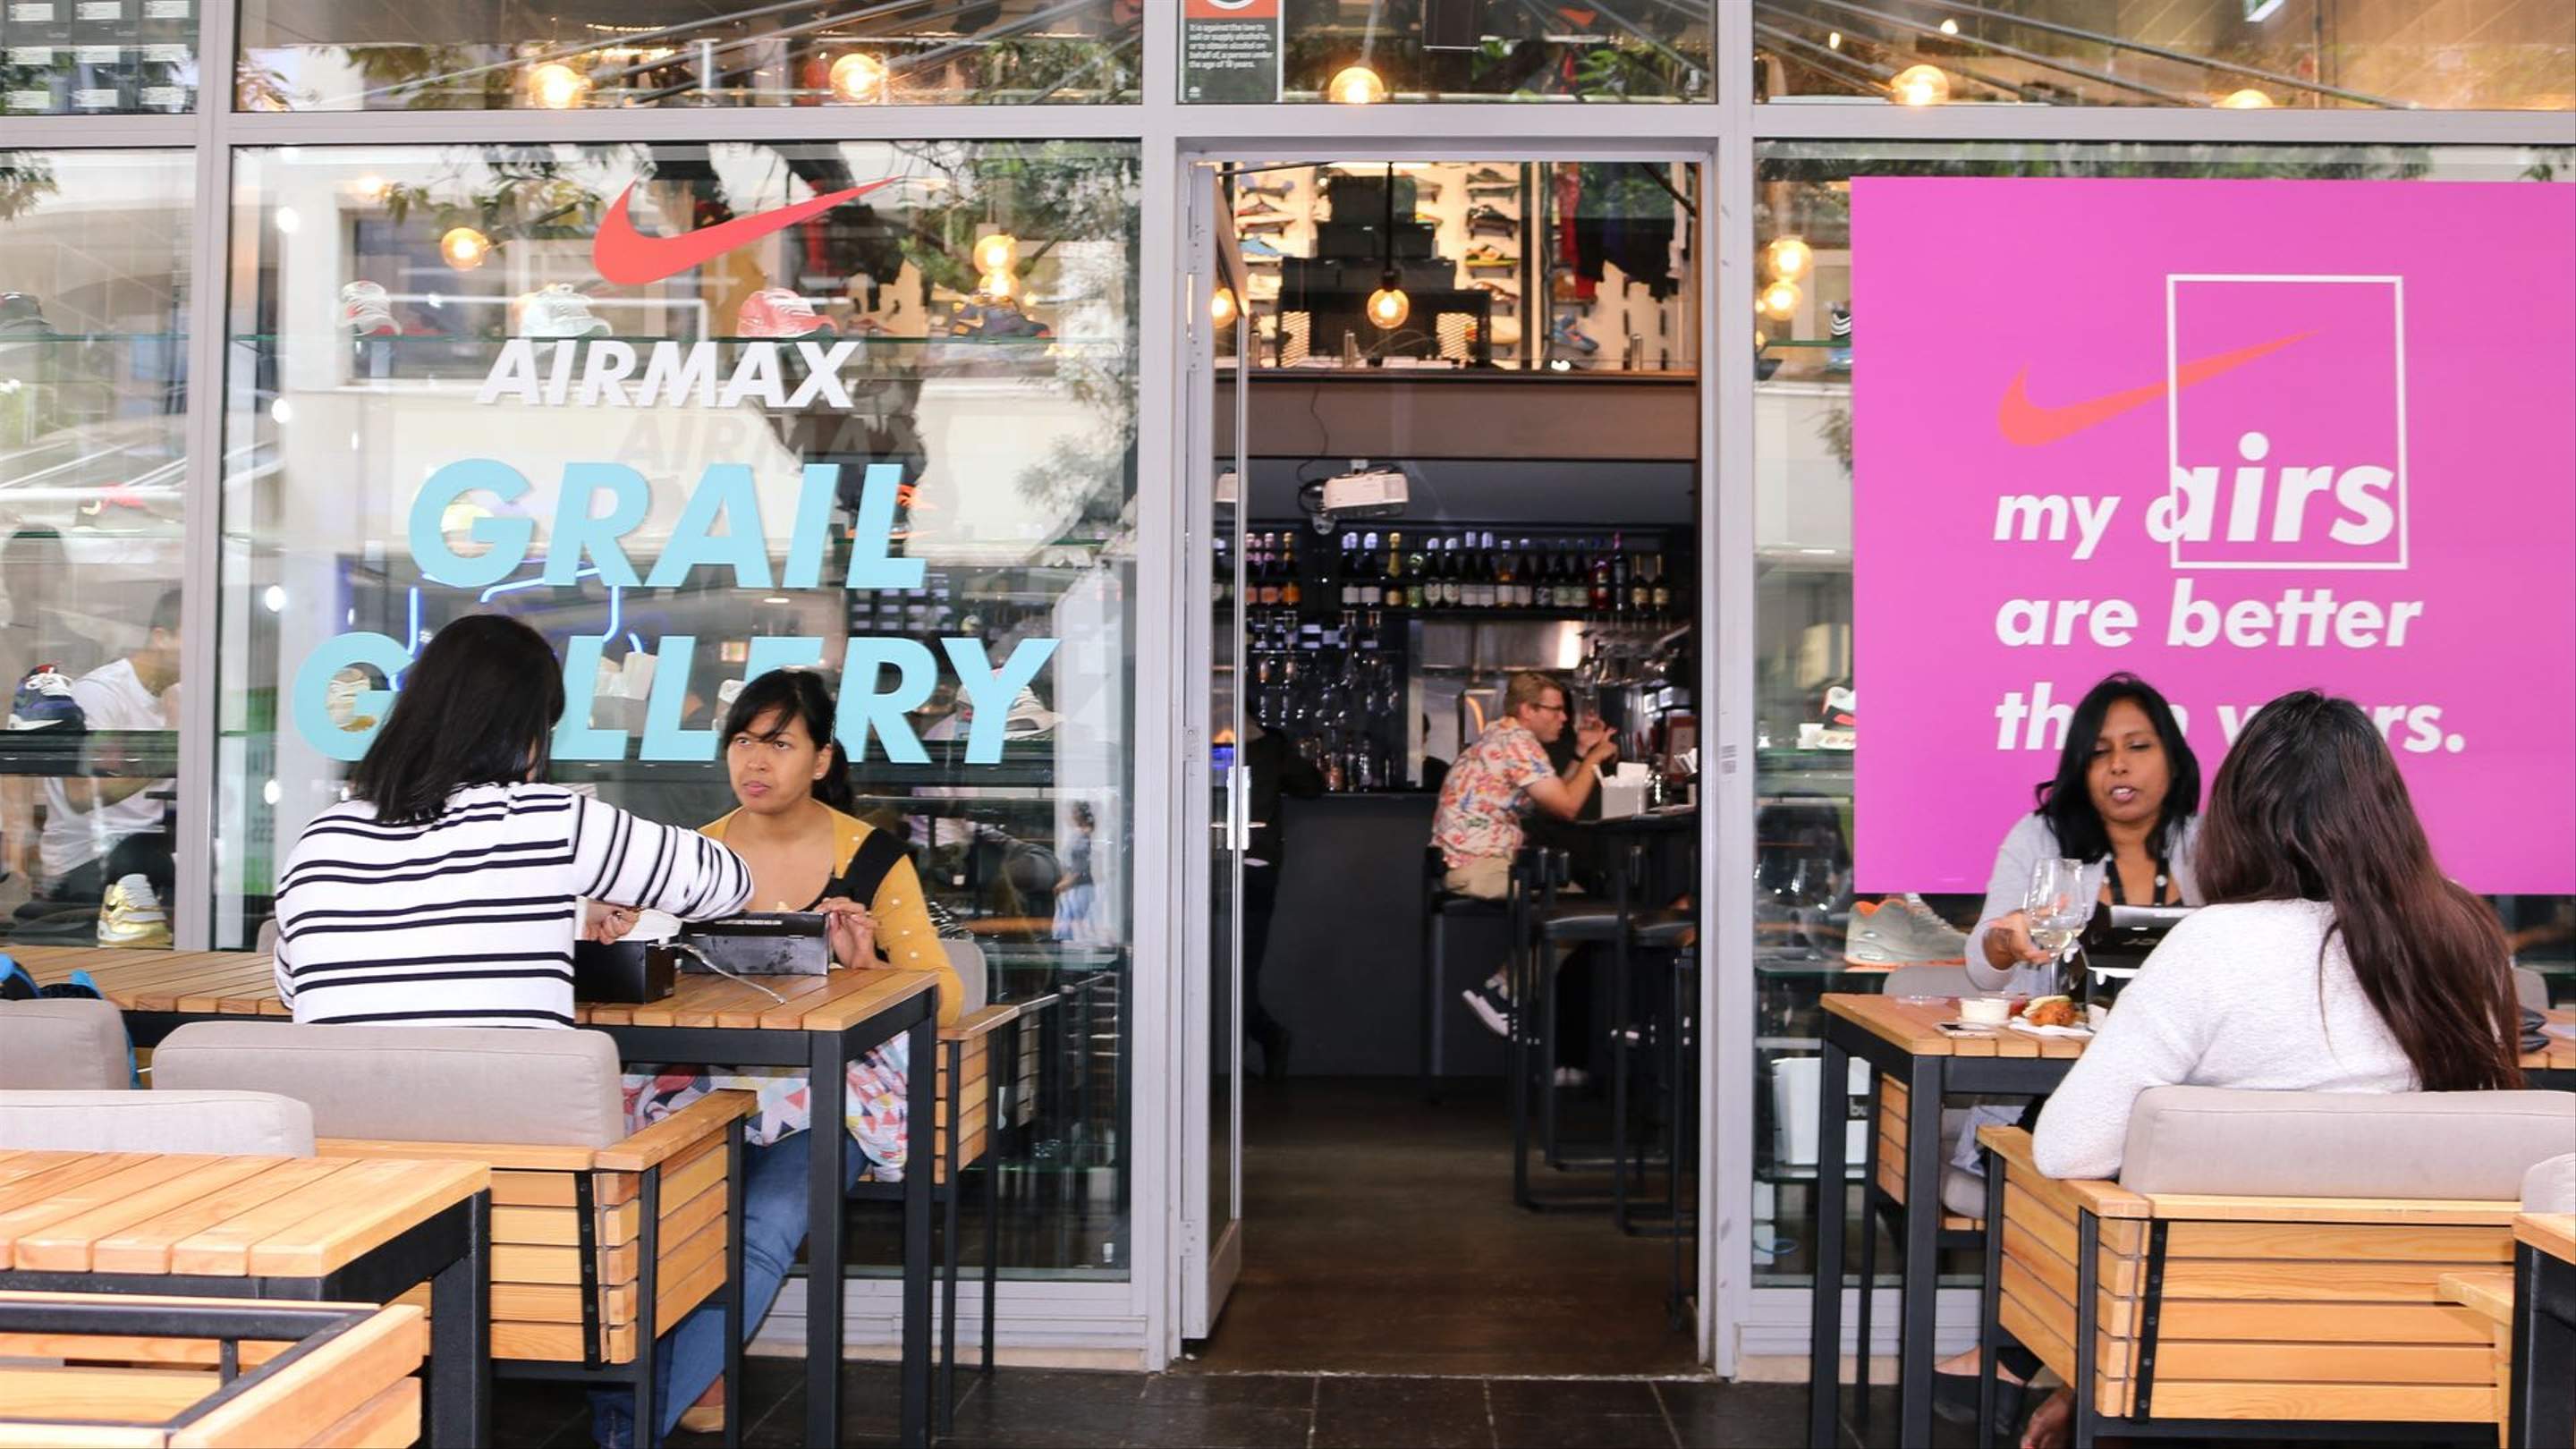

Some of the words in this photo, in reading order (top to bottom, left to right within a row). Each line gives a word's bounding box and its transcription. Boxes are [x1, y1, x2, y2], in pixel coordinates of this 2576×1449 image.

[474, 338, 861, 410] AIRMAX
[408, 458, 928, 589] GRAIL
[1994, 495, 2121, 560] my
[2146, 431, 2395, 547] airs
[1996, 598, 2139, 647] are
[2167, 578, 2424, 648] better
[292, 631, 1062, 765] GLLRY
[1996, 682, 2188, 750] th
[2216, 705, 2465, 752] rs.
